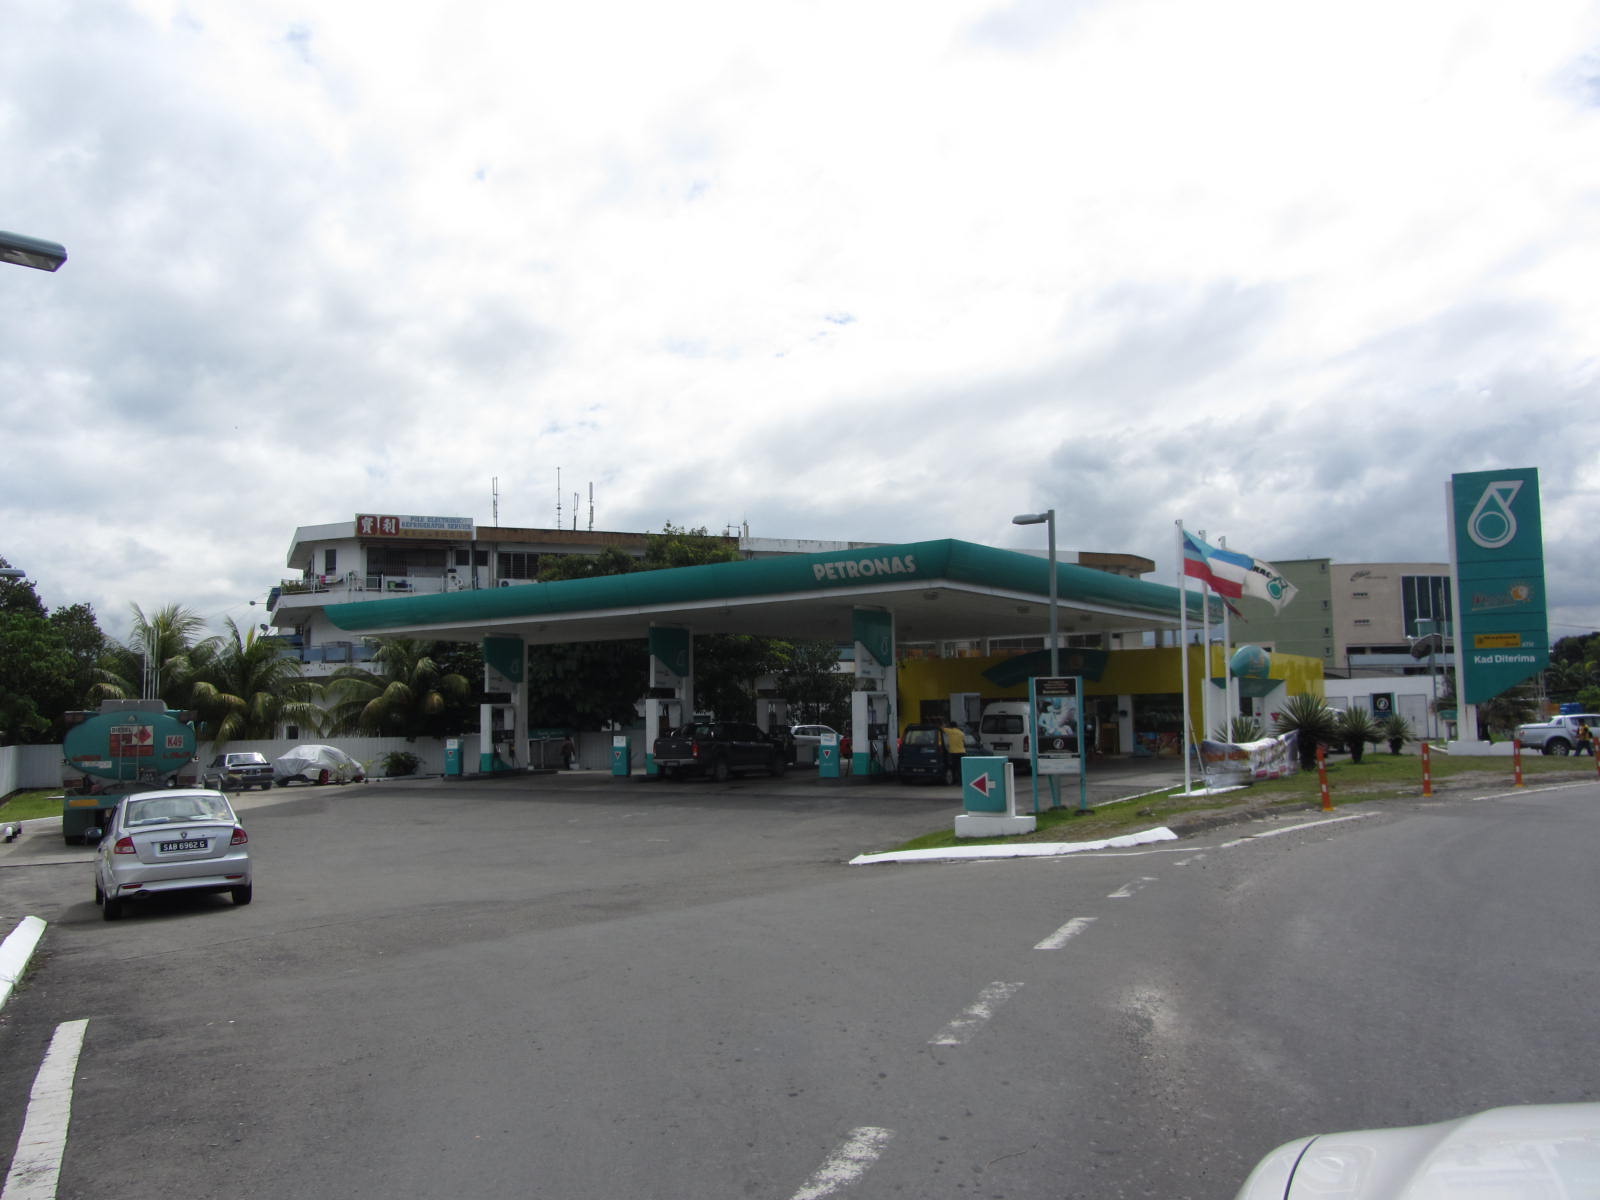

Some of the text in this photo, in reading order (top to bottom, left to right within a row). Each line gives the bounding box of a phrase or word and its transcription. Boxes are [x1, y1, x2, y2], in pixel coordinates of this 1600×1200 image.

[812, 554, 916, 580] PETRONAS
[1474, 654, 1536, 664] Kad Diterima
[167, 736, 183, 747] K49
[163, 843, 178, 851] SAB
